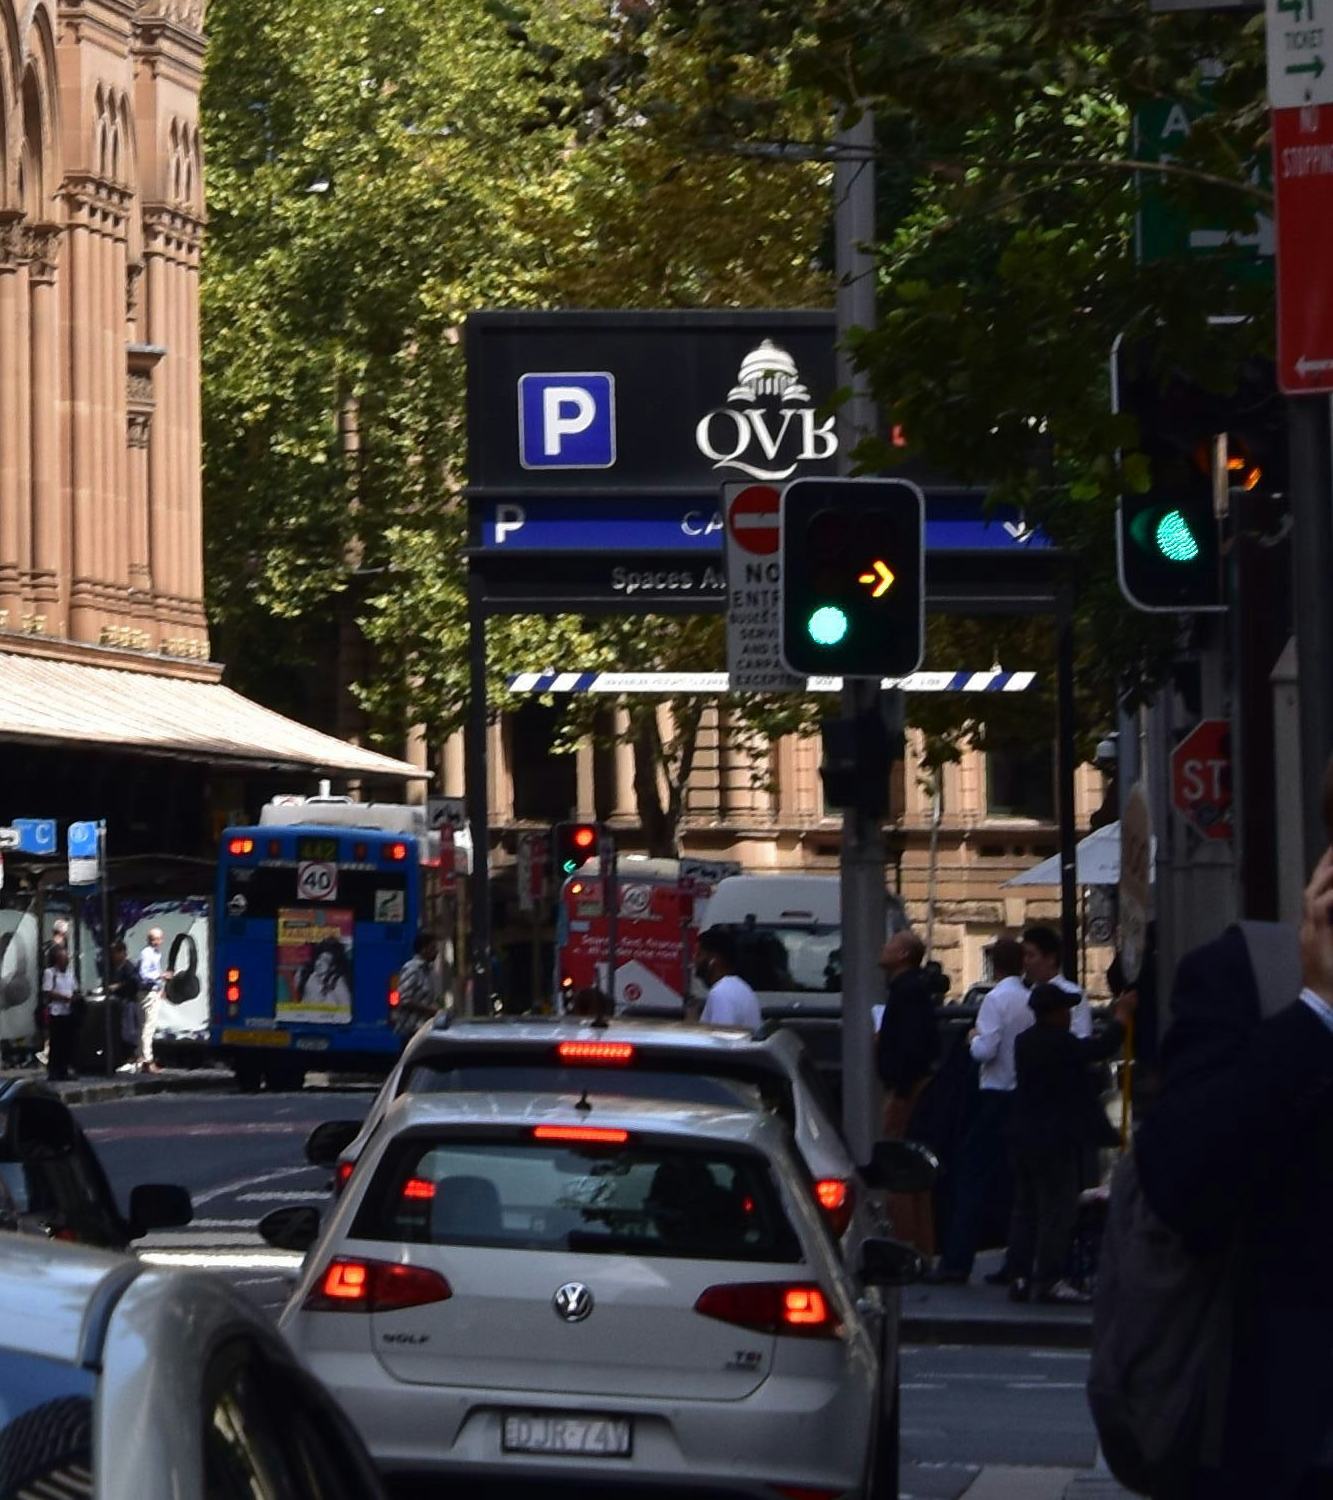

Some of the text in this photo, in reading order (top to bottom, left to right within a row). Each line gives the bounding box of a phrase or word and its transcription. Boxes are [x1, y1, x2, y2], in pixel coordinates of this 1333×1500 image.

[1285, 28, 1324, 51] TICKET
[544, 386, 595, 455] P
[695, 407, 840, 481] QVB
[495, 504, 526, 544] P
[612, 566, 694, 595] Spaces
[746, 563, 779, 583] NO
[1183, 759, 1228, 801] ST
[35, 823, 51, 844] C
[303, 871, 331, 890] 40
